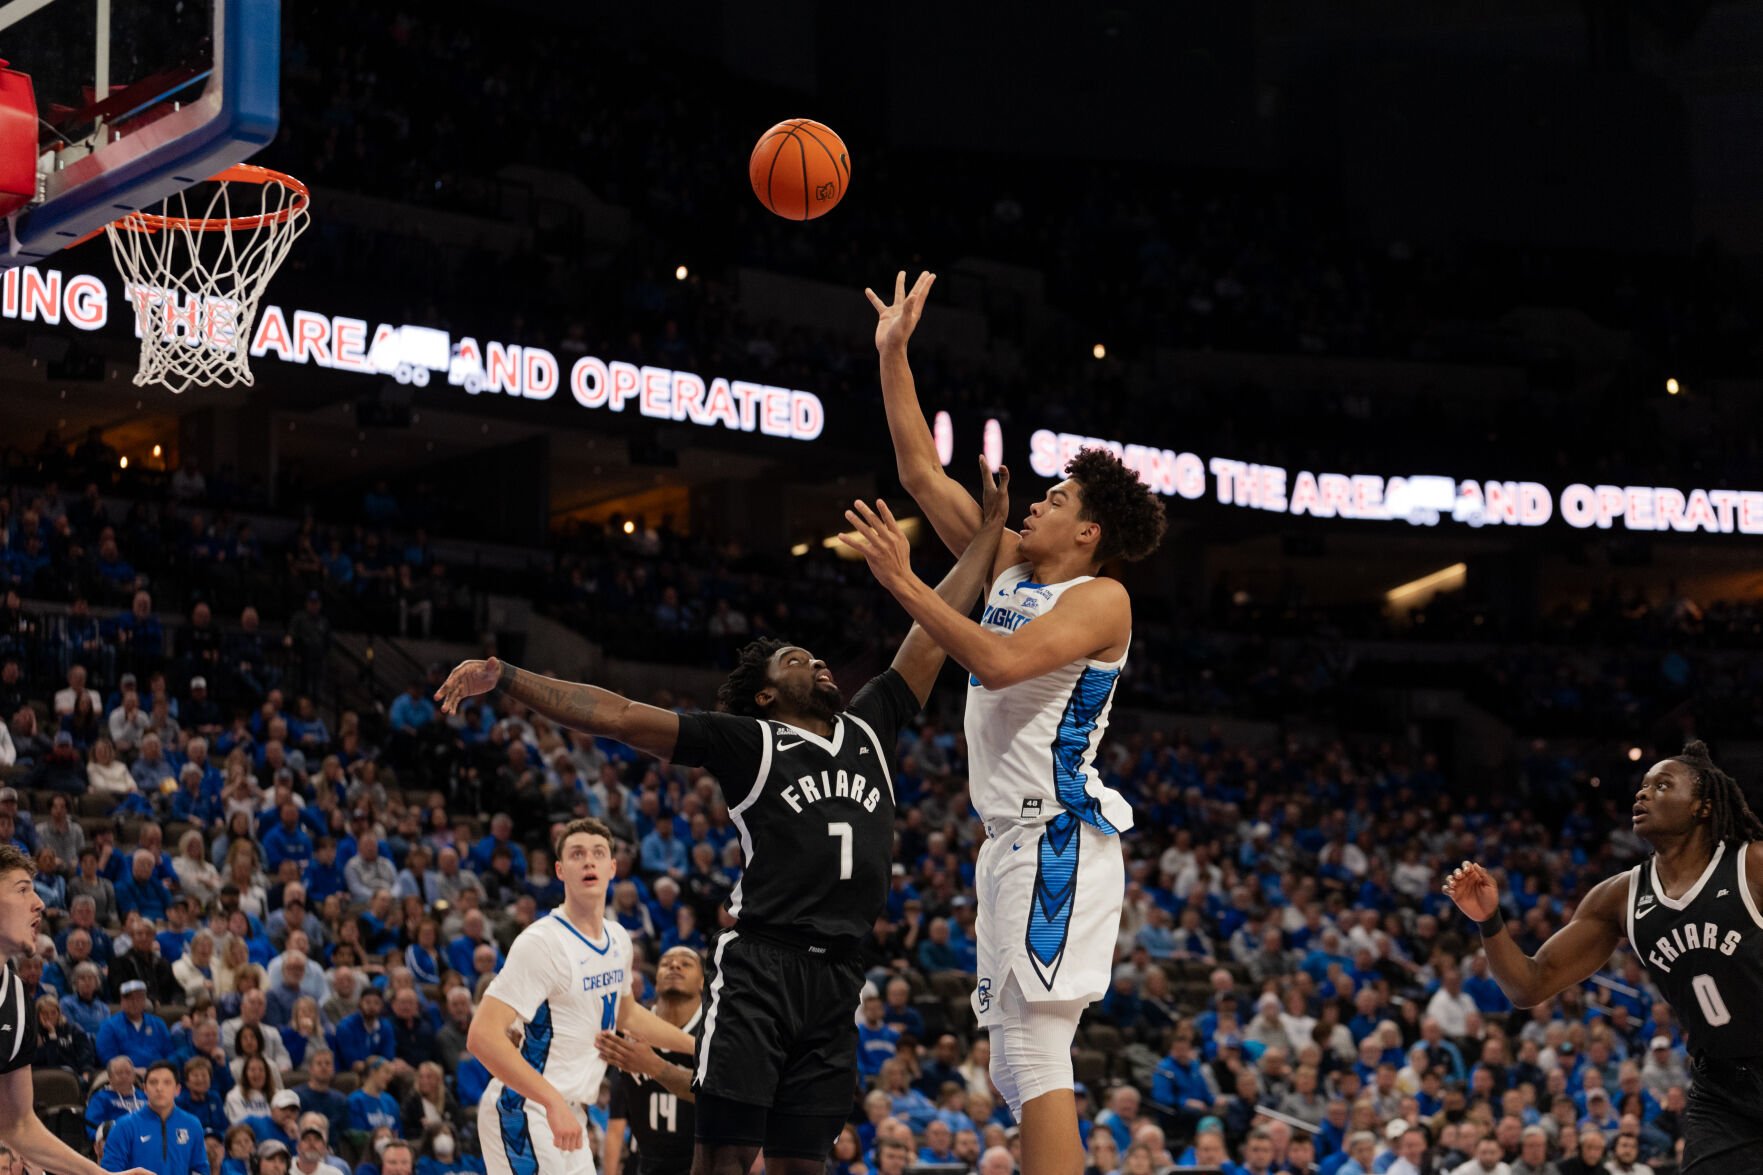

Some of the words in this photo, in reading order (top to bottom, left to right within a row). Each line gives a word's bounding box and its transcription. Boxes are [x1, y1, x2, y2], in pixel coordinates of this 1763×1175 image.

[0, 265, 108, 331] ING
[124, 282, 238, 353] THE
[570, 356, 824, 441] OPERATED
[1209, 457, 1288, 512] THE
[1560, 483, 1763, 534] OPERATE
[780, 769, 881, 814] FRIARS
[828, 822, 854, 880] 7
[1648, 921, 1742, 973] FRIARS
[1691, 973, 1731, 1027] 0
[649, 1092, 677, 1132] 14
